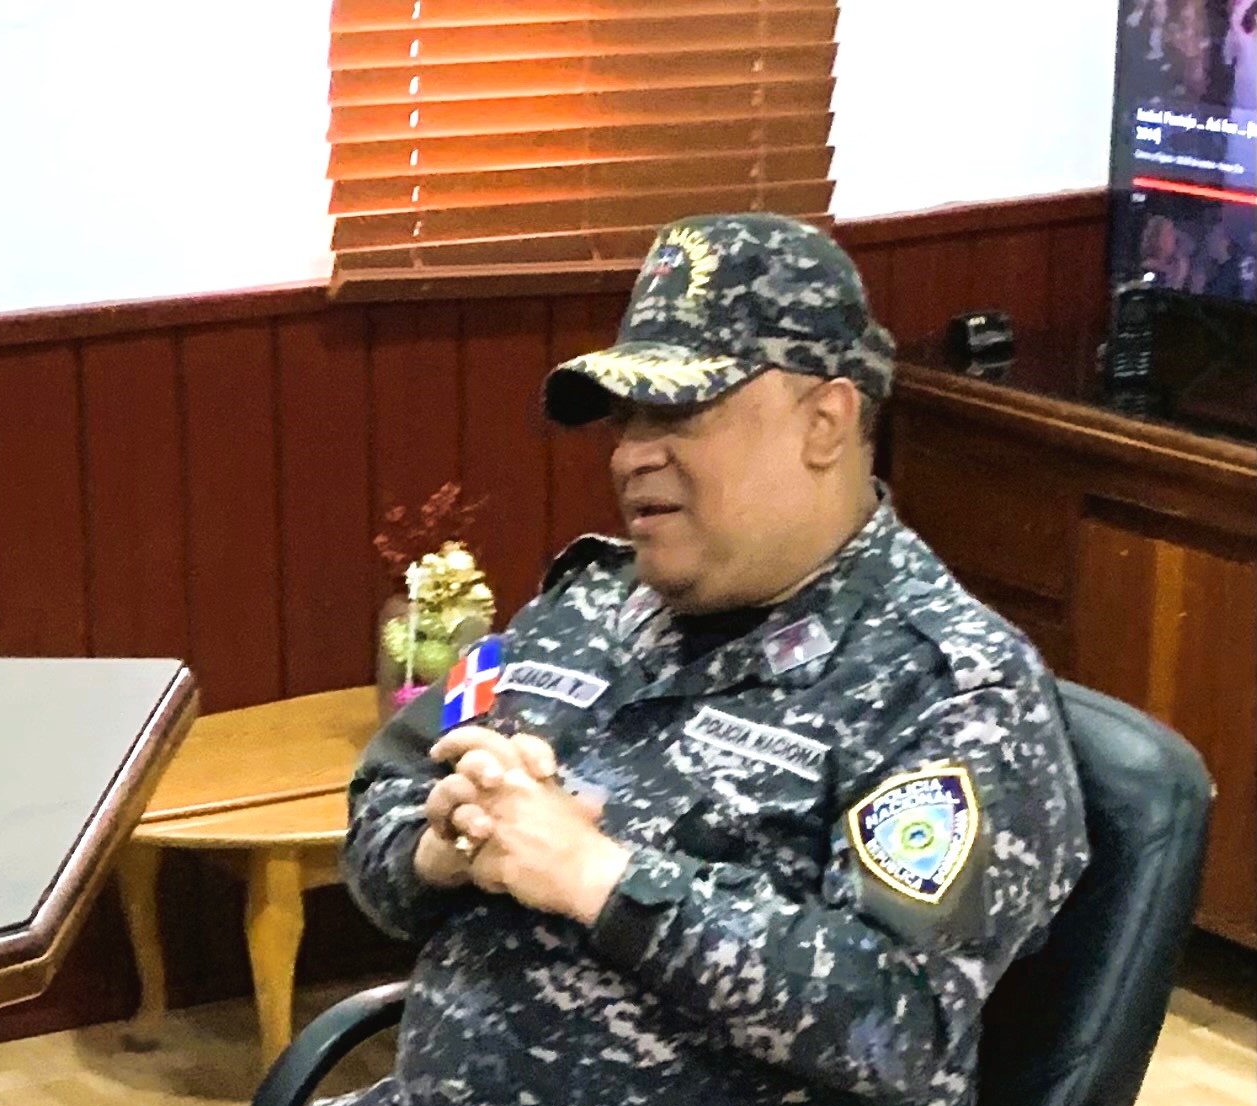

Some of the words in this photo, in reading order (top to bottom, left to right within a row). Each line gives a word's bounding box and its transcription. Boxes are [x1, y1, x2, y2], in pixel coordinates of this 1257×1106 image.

[695, 716, 751, 745] POLICIA
[753, 733, 824, 767] NACIONA
[865, 790, 960, 829] NACIONAL
[873, 778, 943, 812] POLICIA
